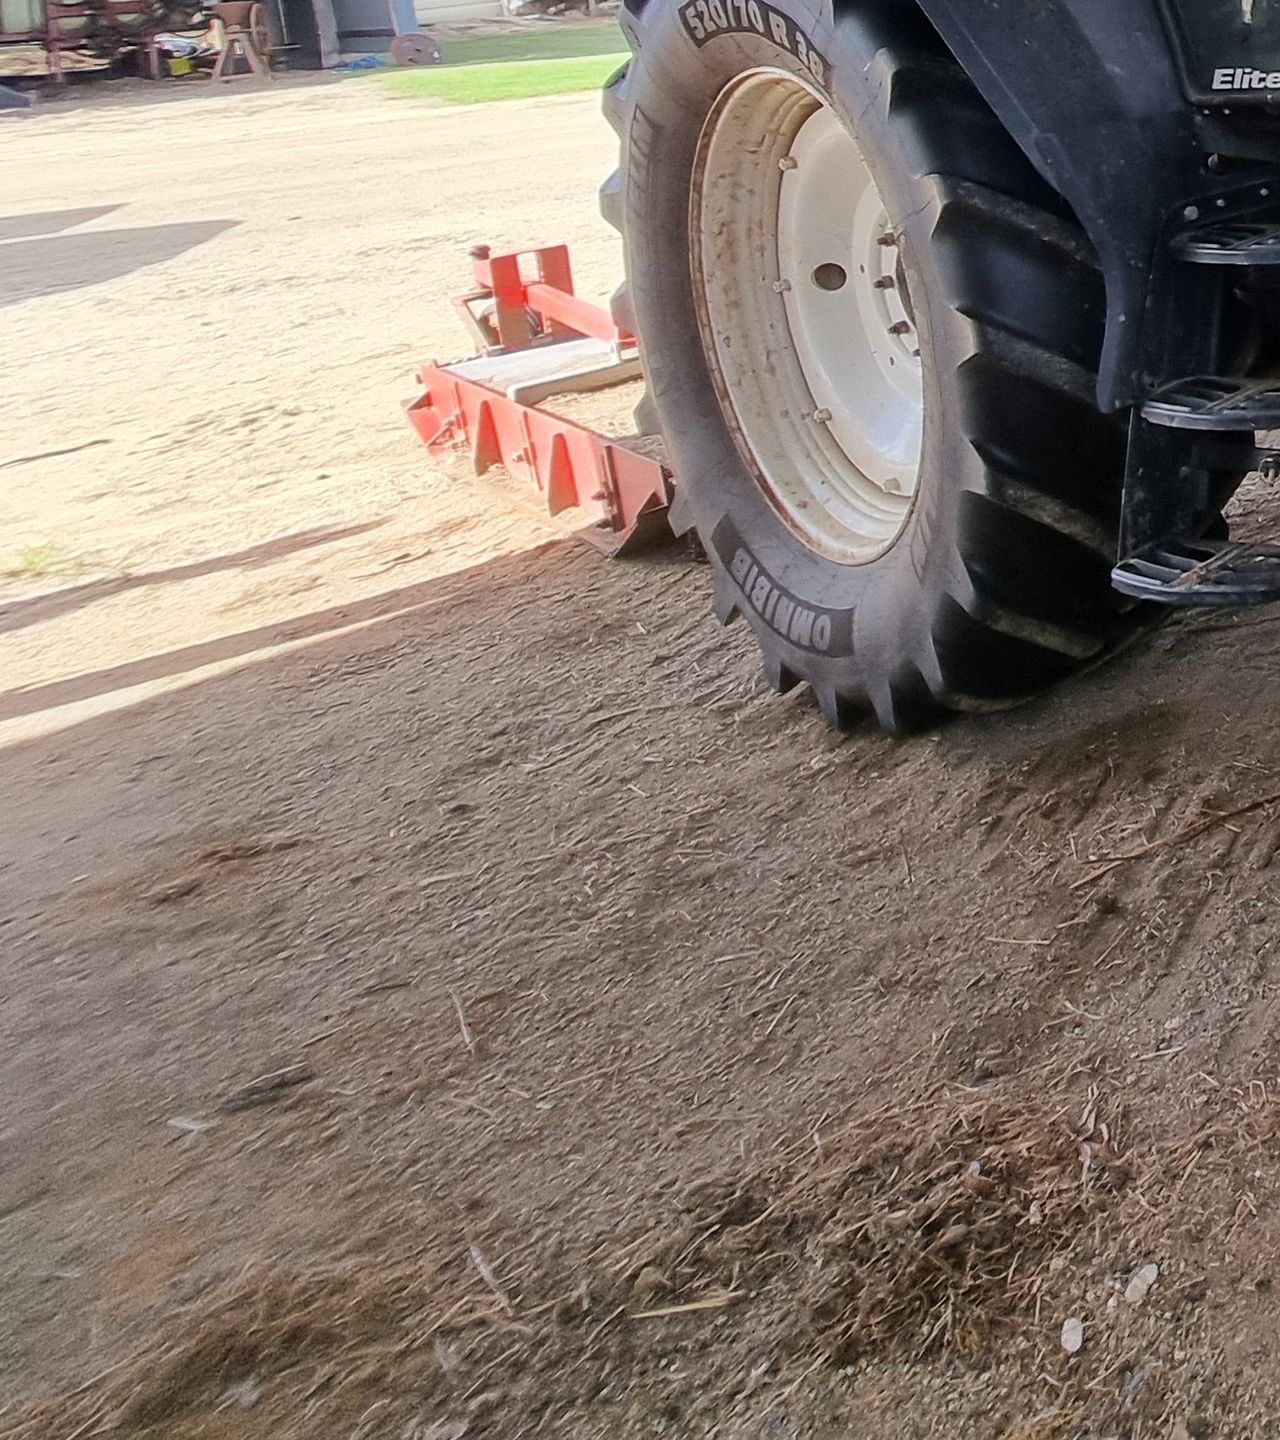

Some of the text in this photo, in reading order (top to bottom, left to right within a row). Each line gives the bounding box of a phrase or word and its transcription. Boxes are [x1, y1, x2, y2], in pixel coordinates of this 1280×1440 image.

[768, 11, 791, 50] R
[795, 30, 826, 87] 38
[730, 547, 832, 652] OMNIBIB
